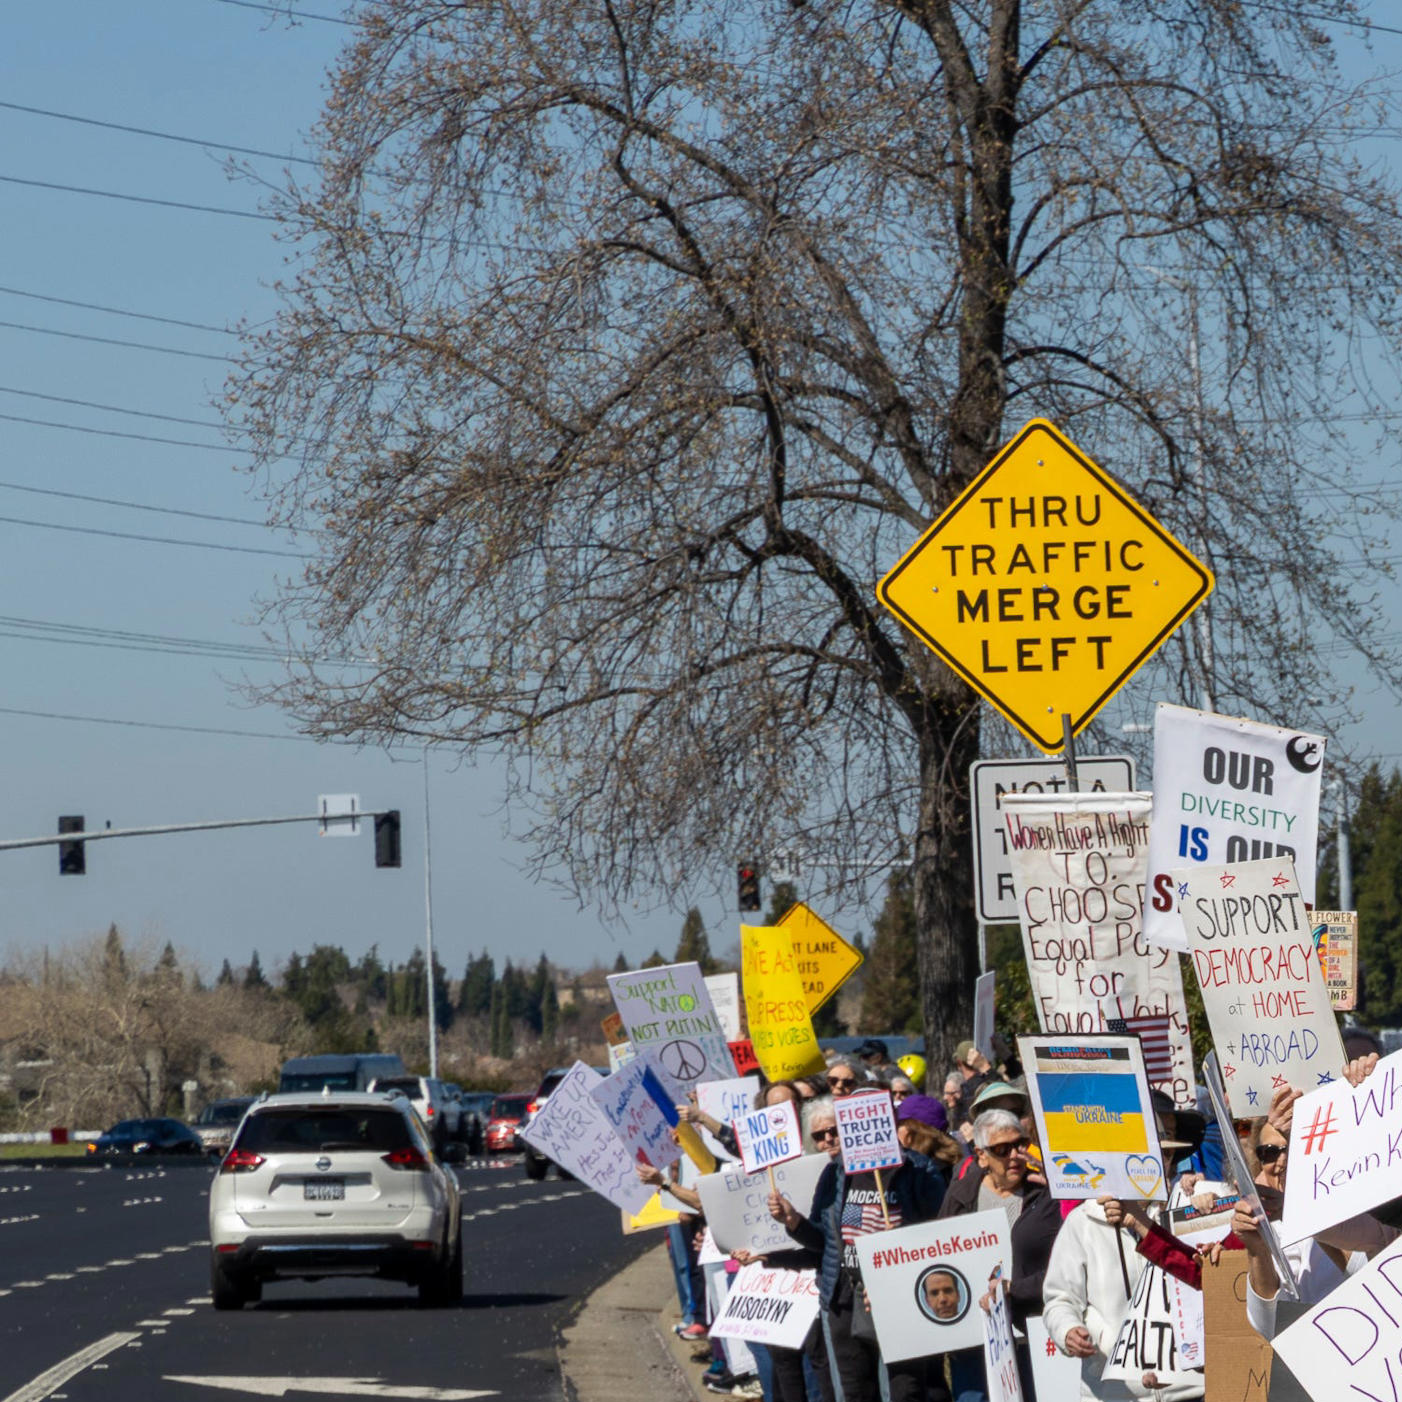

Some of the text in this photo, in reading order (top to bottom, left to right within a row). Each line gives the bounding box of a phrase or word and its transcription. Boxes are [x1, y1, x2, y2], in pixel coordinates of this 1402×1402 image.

[980, 495, 1102, 528] THRU
[941, 541, 1145, 576] TRAFFIC
[957, 584, 1133, 624] MERGE
[981, 636, 1113, 674] LEFT
[1203, 746, 1275, 796] OUR
[1181, 791, 1297, 833] DIVERSITY
[1005, 810, 1150, 858] Women Have A Right
[1178, 824, 1297, 862] IS OUR
[1196, 892, 1300, 940] SUPPORT
[1316, 911, 1352, 923] FLOWER
[807, 942, 837, 954] LANE
[1028, 922, 1169, 976] Equal Pay
[1194, 943, 1313, 989] DEMOCRACY
[1075, 960, 1125, 997] for
[1228, 990, 1315, 1019] at HOME
[631, 1021, 660, 1043] NOT
[1240, 1029, 1320, 1067] ABROAD
[531, 1071, 588, 1143] WAKE UP
[838, 1102, 888, 1122] FIGHT
[1075, 1111, 1124, 1124] UKRAINE
[747, 1113, 770, 1140] NO
[841, 1116, 892, 1136] TRUTH
[844, 1130, 893, 1149] DECAY
[753, 1133, 790, 1165] KING
[1312, 1155, 1384, 1200] Kevin
[751, 1234, 795, 1251] Circu
[873, 1229, 999, 1270] #WhereIsKevin
[725, 1296, 794, 1324] MISOGYNY
